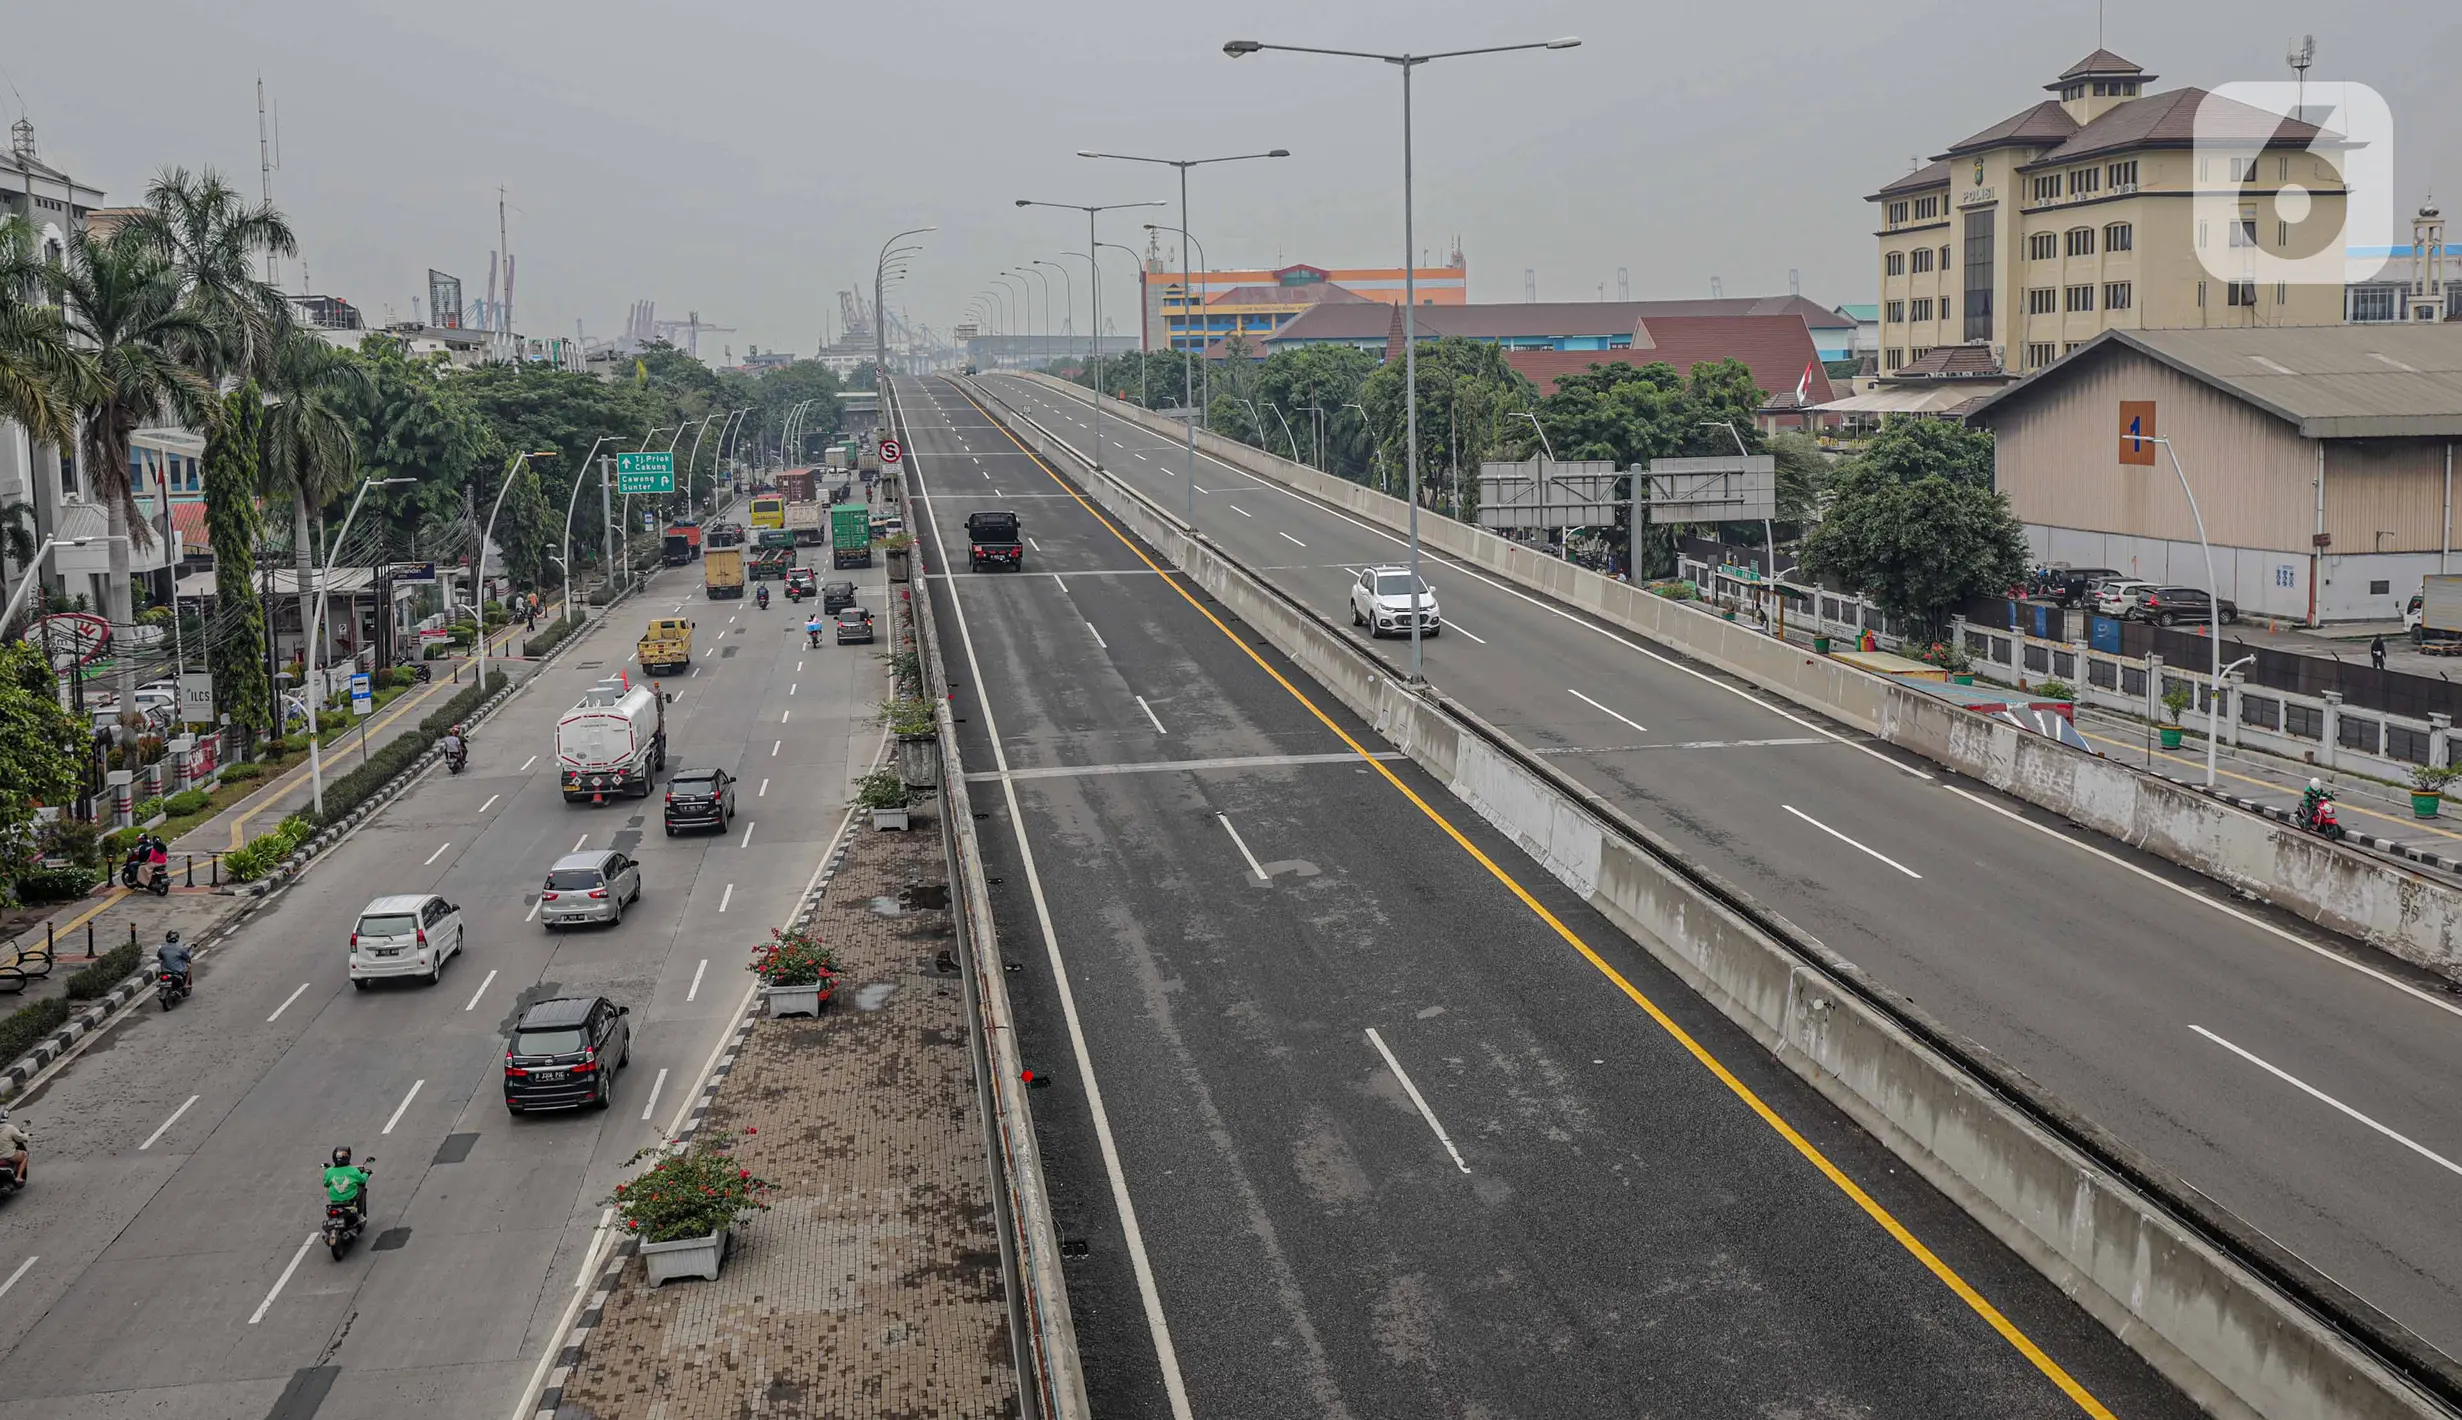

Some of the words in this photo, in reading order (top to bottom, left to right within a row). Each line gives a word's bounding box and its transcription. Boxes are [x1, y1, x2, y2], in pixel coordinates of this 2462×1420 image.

[1963, 186, 1996, 203] POLISI
[2130, 416, 2140, 452] 1
[635, 463, 667, 472] Cakung
[191, 691, 210, 701] ILCS
